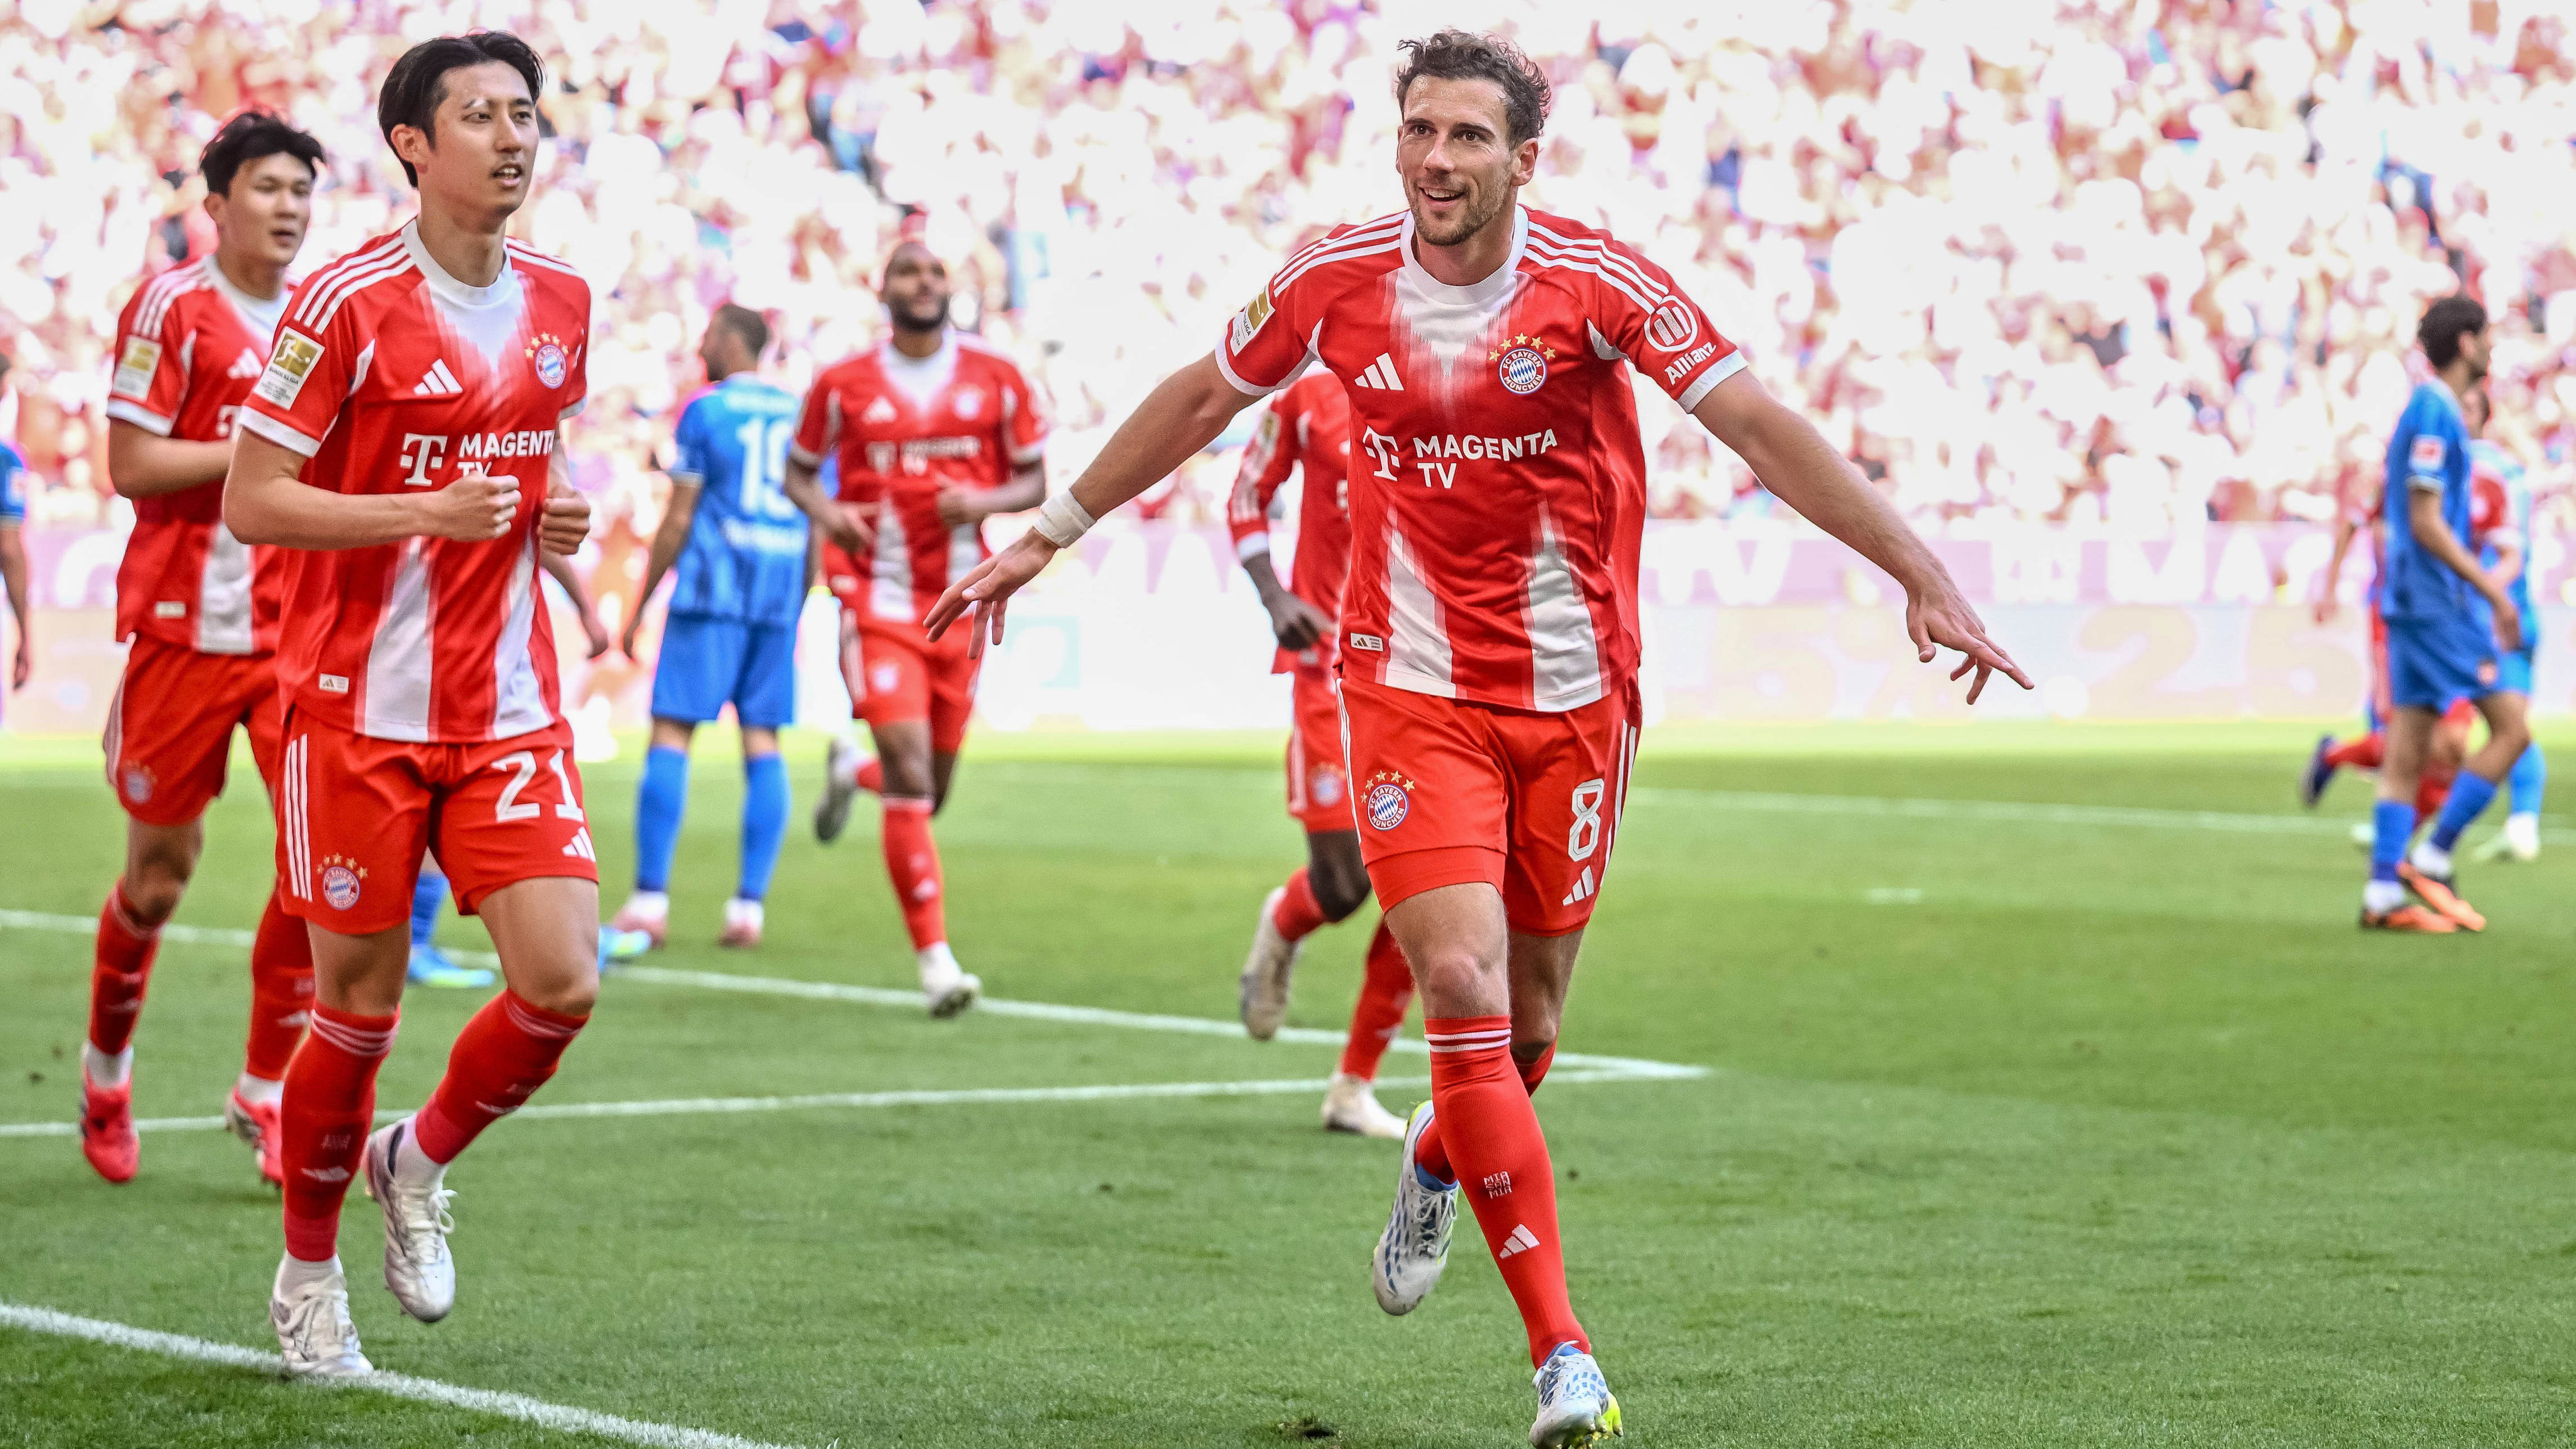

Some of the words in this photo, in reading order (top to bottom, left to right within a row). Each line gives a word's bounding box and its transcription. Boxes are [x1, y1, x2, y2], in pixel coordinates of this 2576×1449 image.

[1503, 358, 1512, 369] FC
[1511, 351, 1542, 367] BAYERN
[1664, 341, 1717, 386] Allianz
[1412, 429, 1558, 462] MAGENTA
[1417, 462, 1457, 489] TV
[490, 748, 585, 824] 21
[1375, 787, 1403, 801] BAYERN
[1568, 778, 1605, 862] 8
